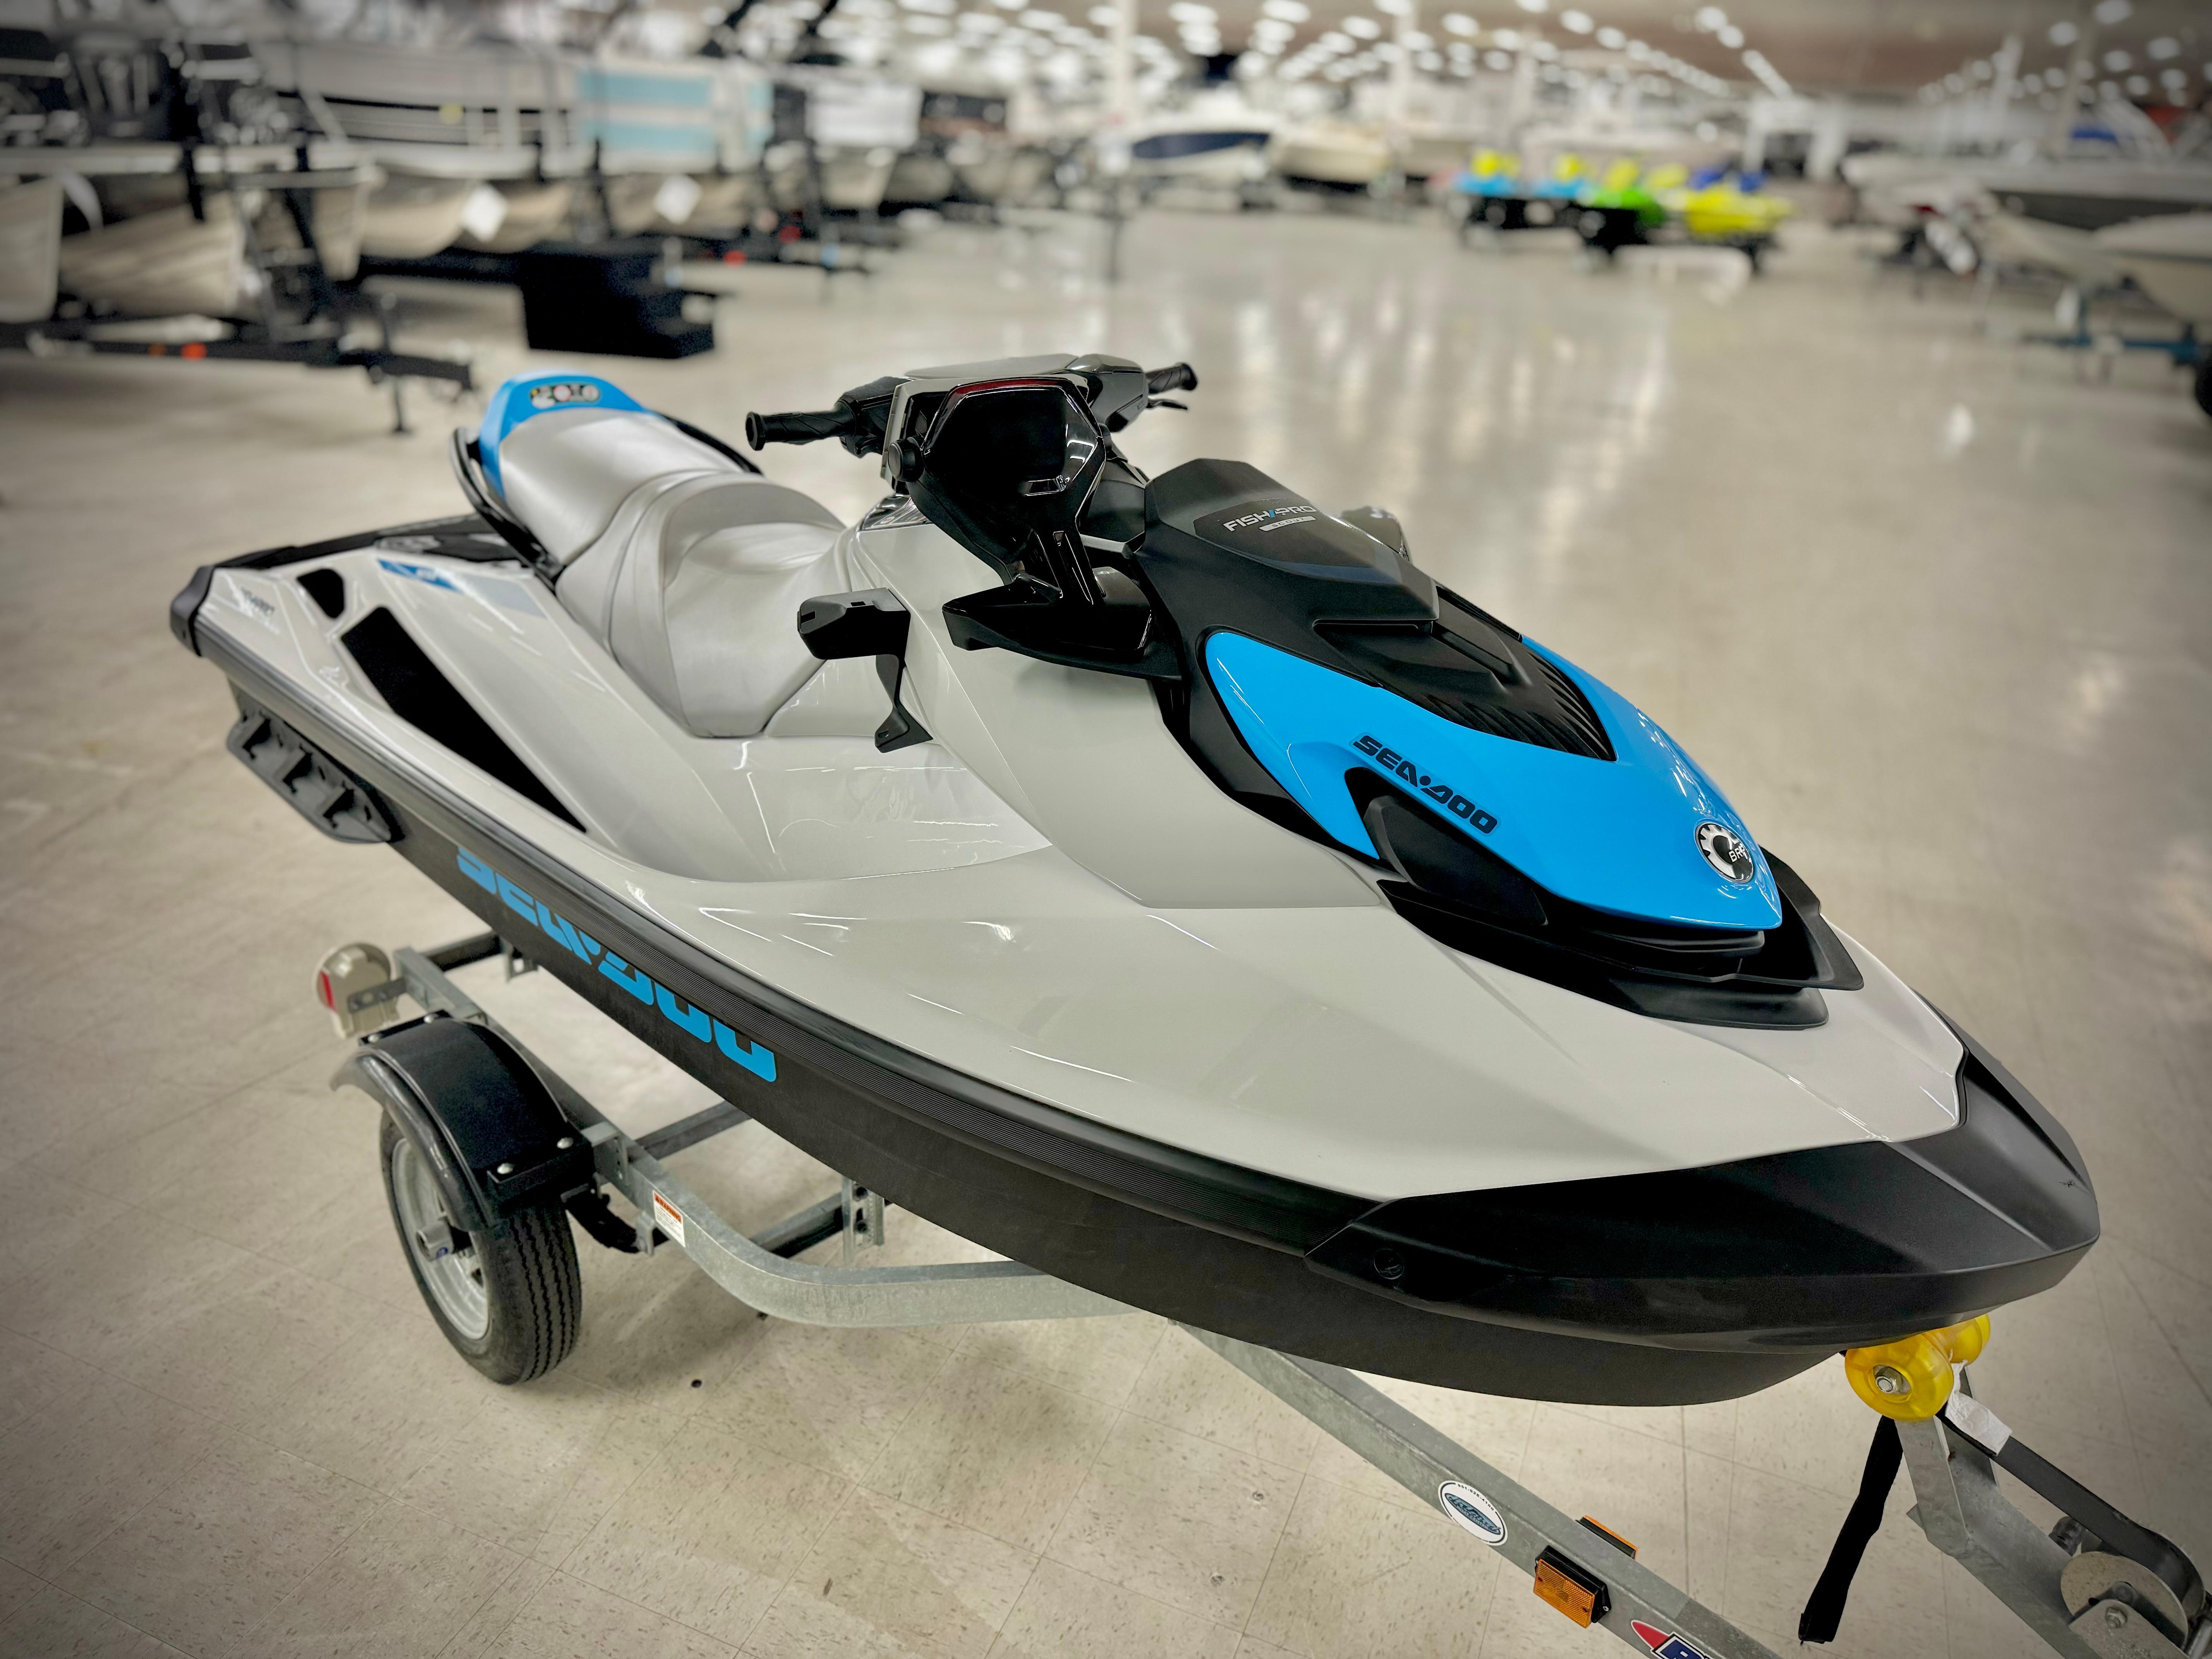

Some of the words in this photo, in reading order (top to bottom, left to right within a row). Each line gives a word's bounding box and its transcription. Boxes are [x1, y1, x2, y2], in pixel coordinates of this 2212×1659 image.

[1271, 518, 1305, 527] SCOUT
[1729, 846, 1745, 862] BRP
[658, 1197, 681, 1222] WARNING
